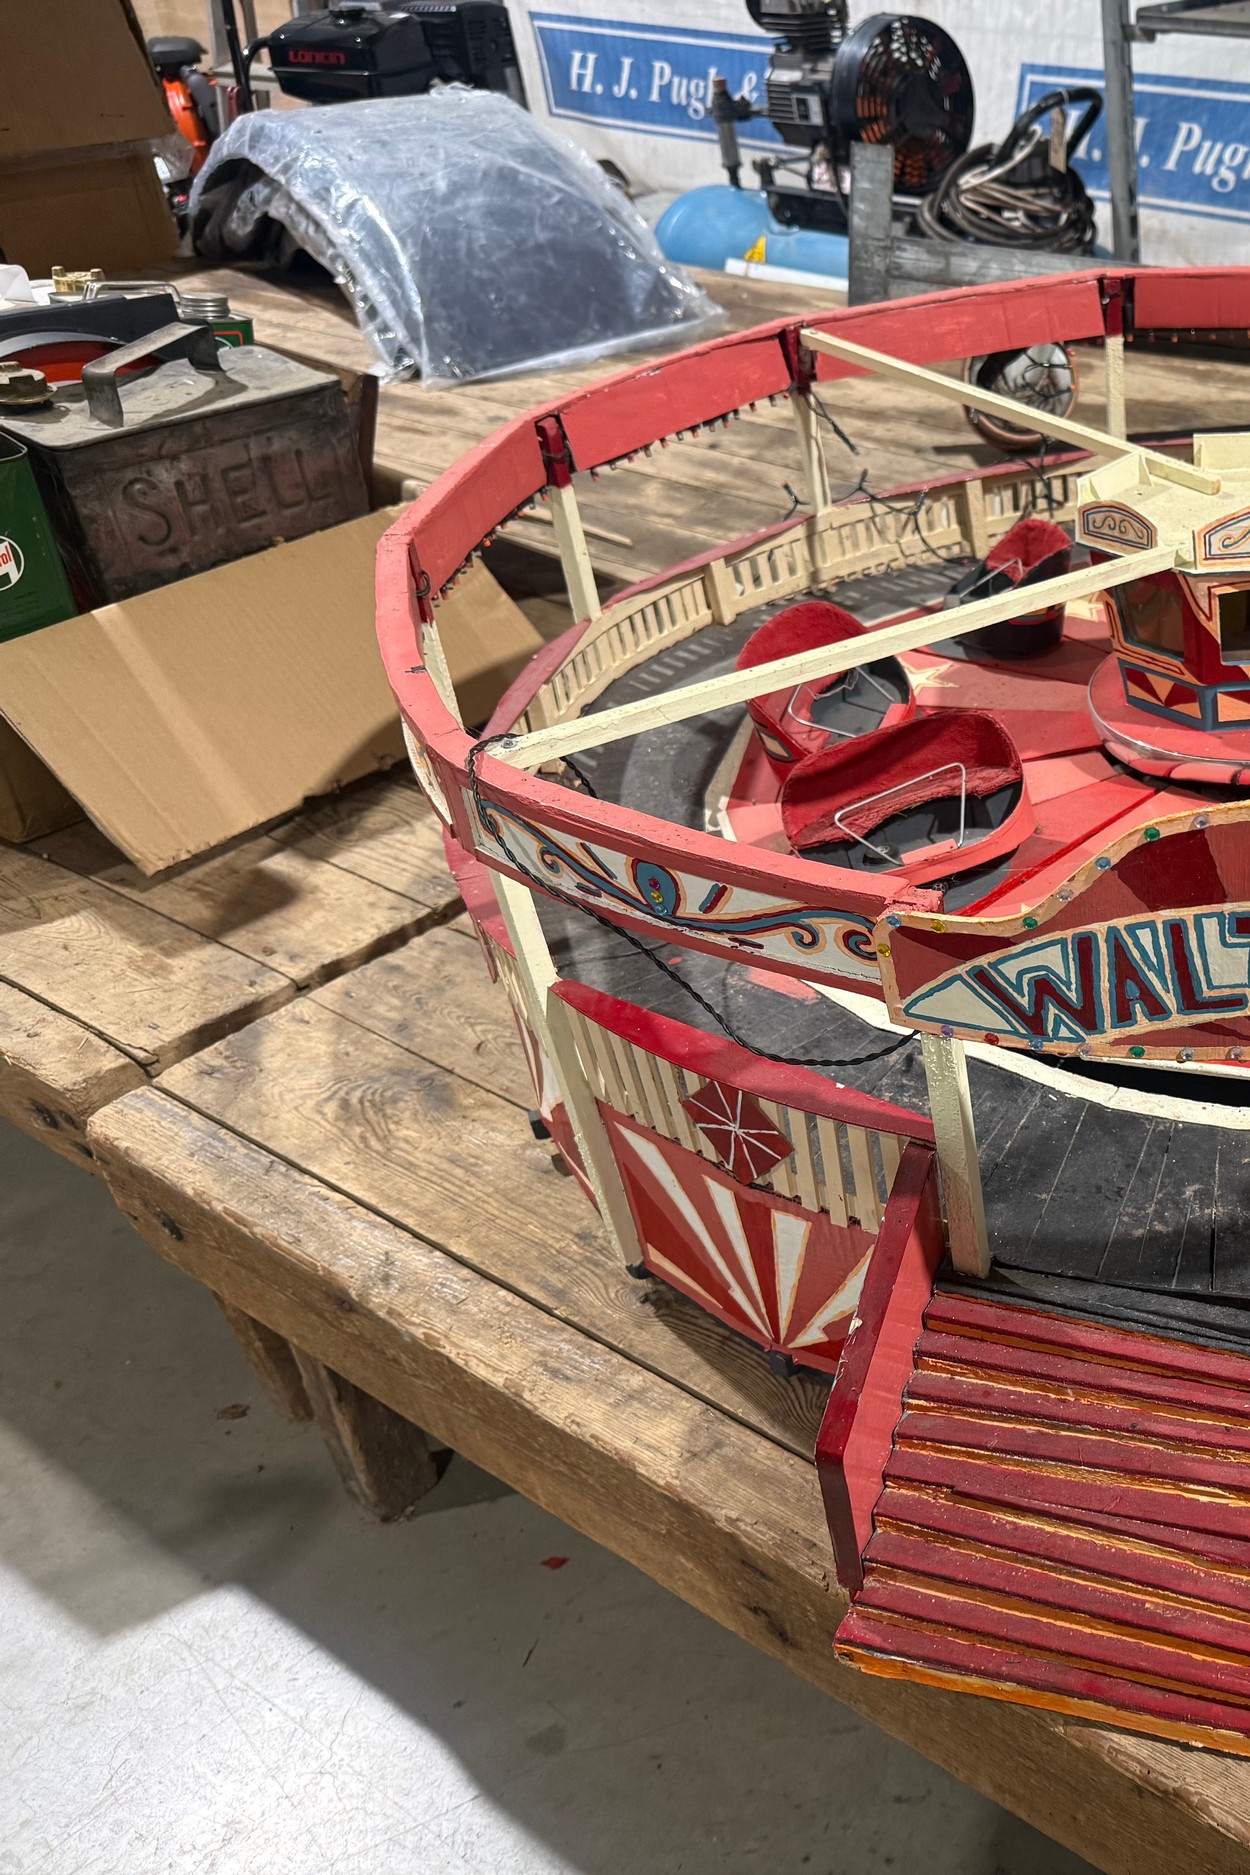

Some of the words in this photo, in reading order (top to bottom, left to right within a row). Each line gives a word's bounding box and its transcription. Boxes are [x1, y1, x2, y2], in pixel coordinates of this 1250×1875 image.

[569, 50, 603, 95] H.
[613, 56, 638, 99] J.
[122, 449, 336, 547] SHELL
